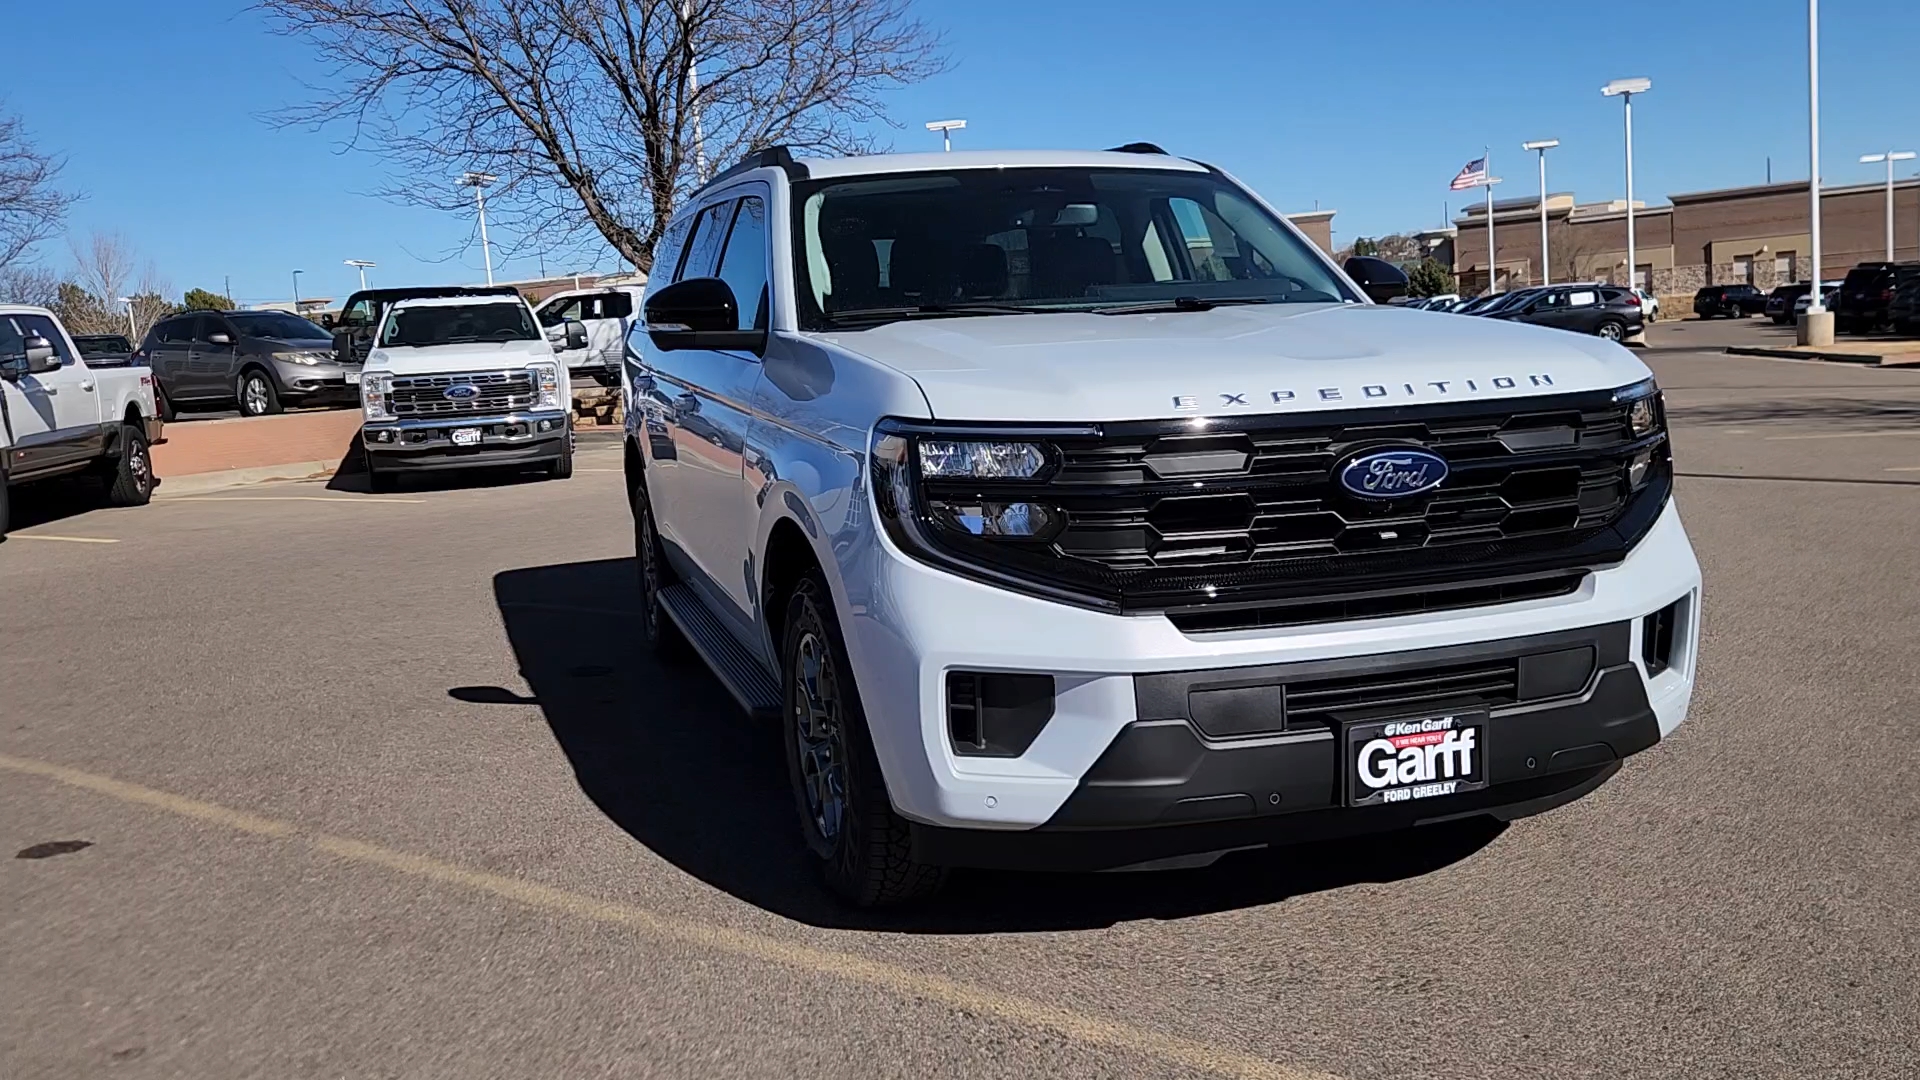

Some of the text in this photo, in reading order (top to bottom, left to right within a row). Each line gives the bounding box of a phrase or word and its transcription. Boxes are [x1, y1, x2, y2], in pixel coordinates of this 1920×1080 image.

[1171, 373, 1554, 410] EXPEDITION
[1363, 458, 1428, 490] Ford
[1395, 717, 1453, 735] Ken Garff
[1358, 728, 1475, 788] Garff
[1384, 782, 1457, 803] FORD GREELEY
